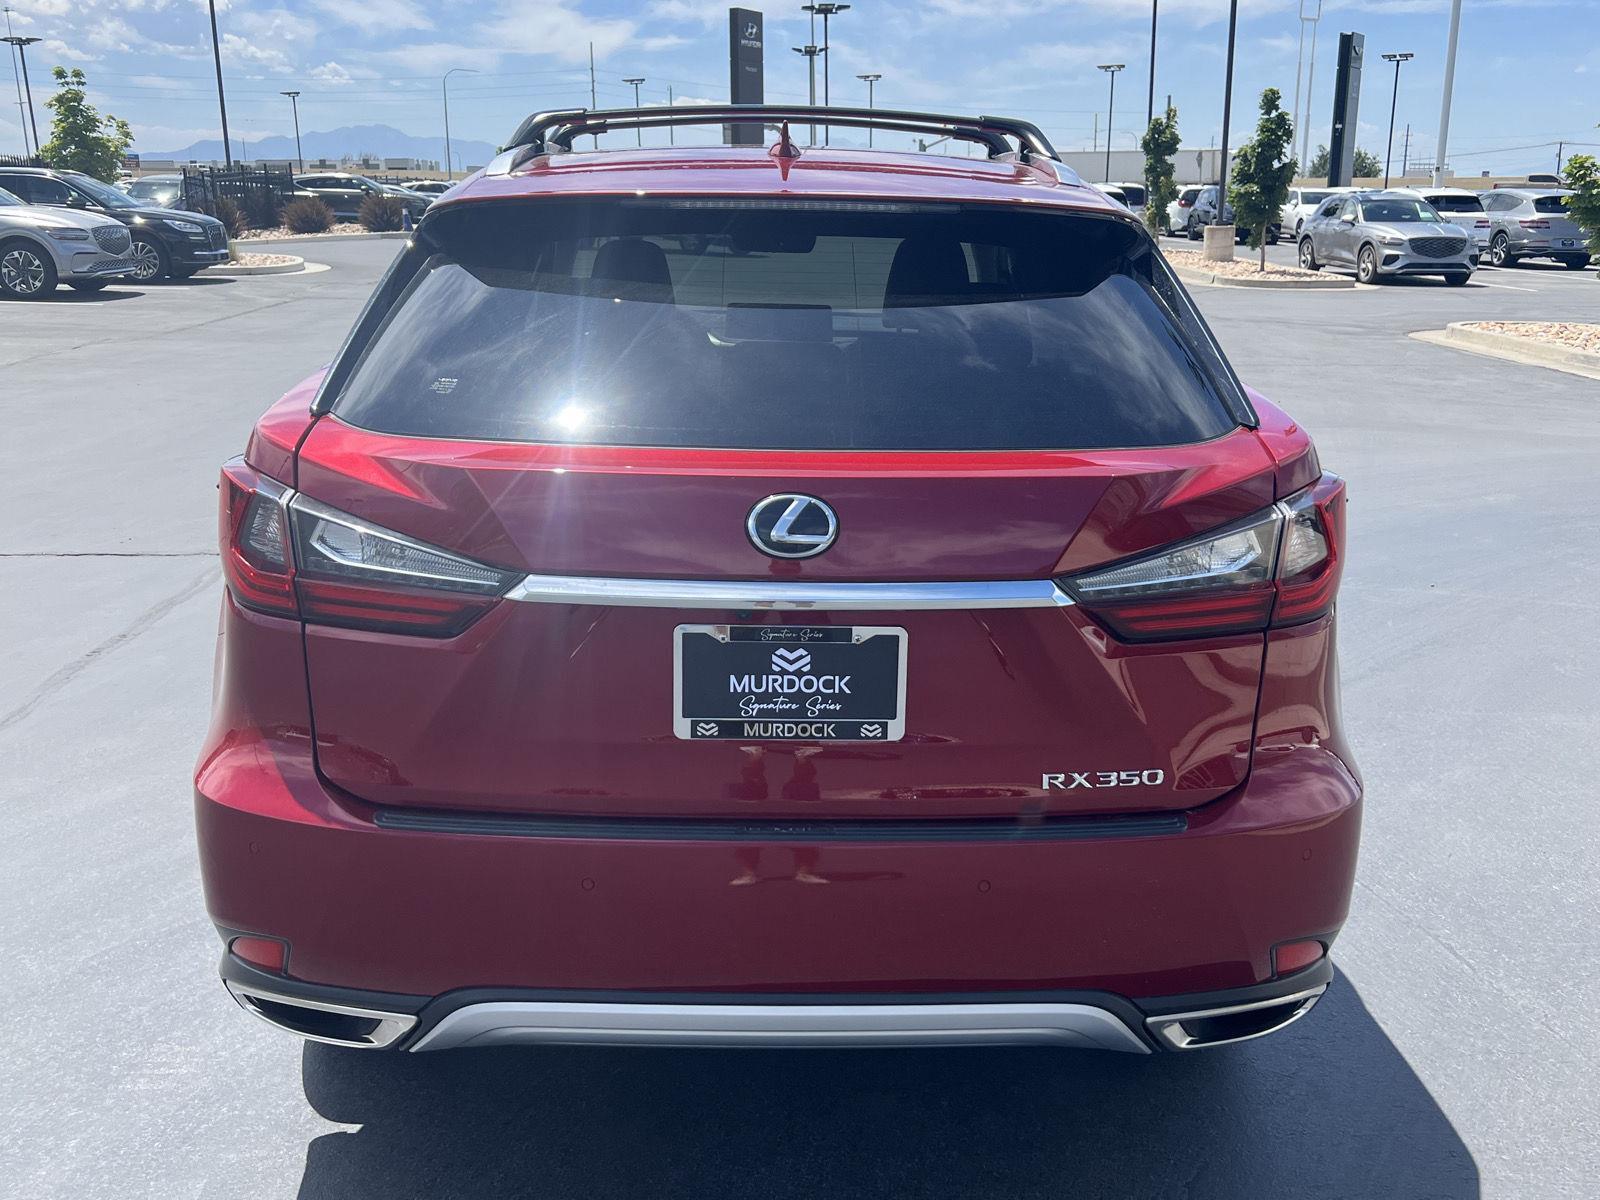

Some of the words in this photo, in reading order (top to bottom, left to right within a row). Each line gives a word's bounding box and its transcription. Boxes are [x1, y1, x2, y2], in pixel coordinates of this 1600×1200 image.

[760, 628, 798, 641] Signature
[800, 628, 824, 641] Series
[729, 674, 852, 694] MURDOCK
[739, 695, 800, 717] Signature
[805, 695, 842, 717] Series
[743, 722, 836, 738] MURDOCK
